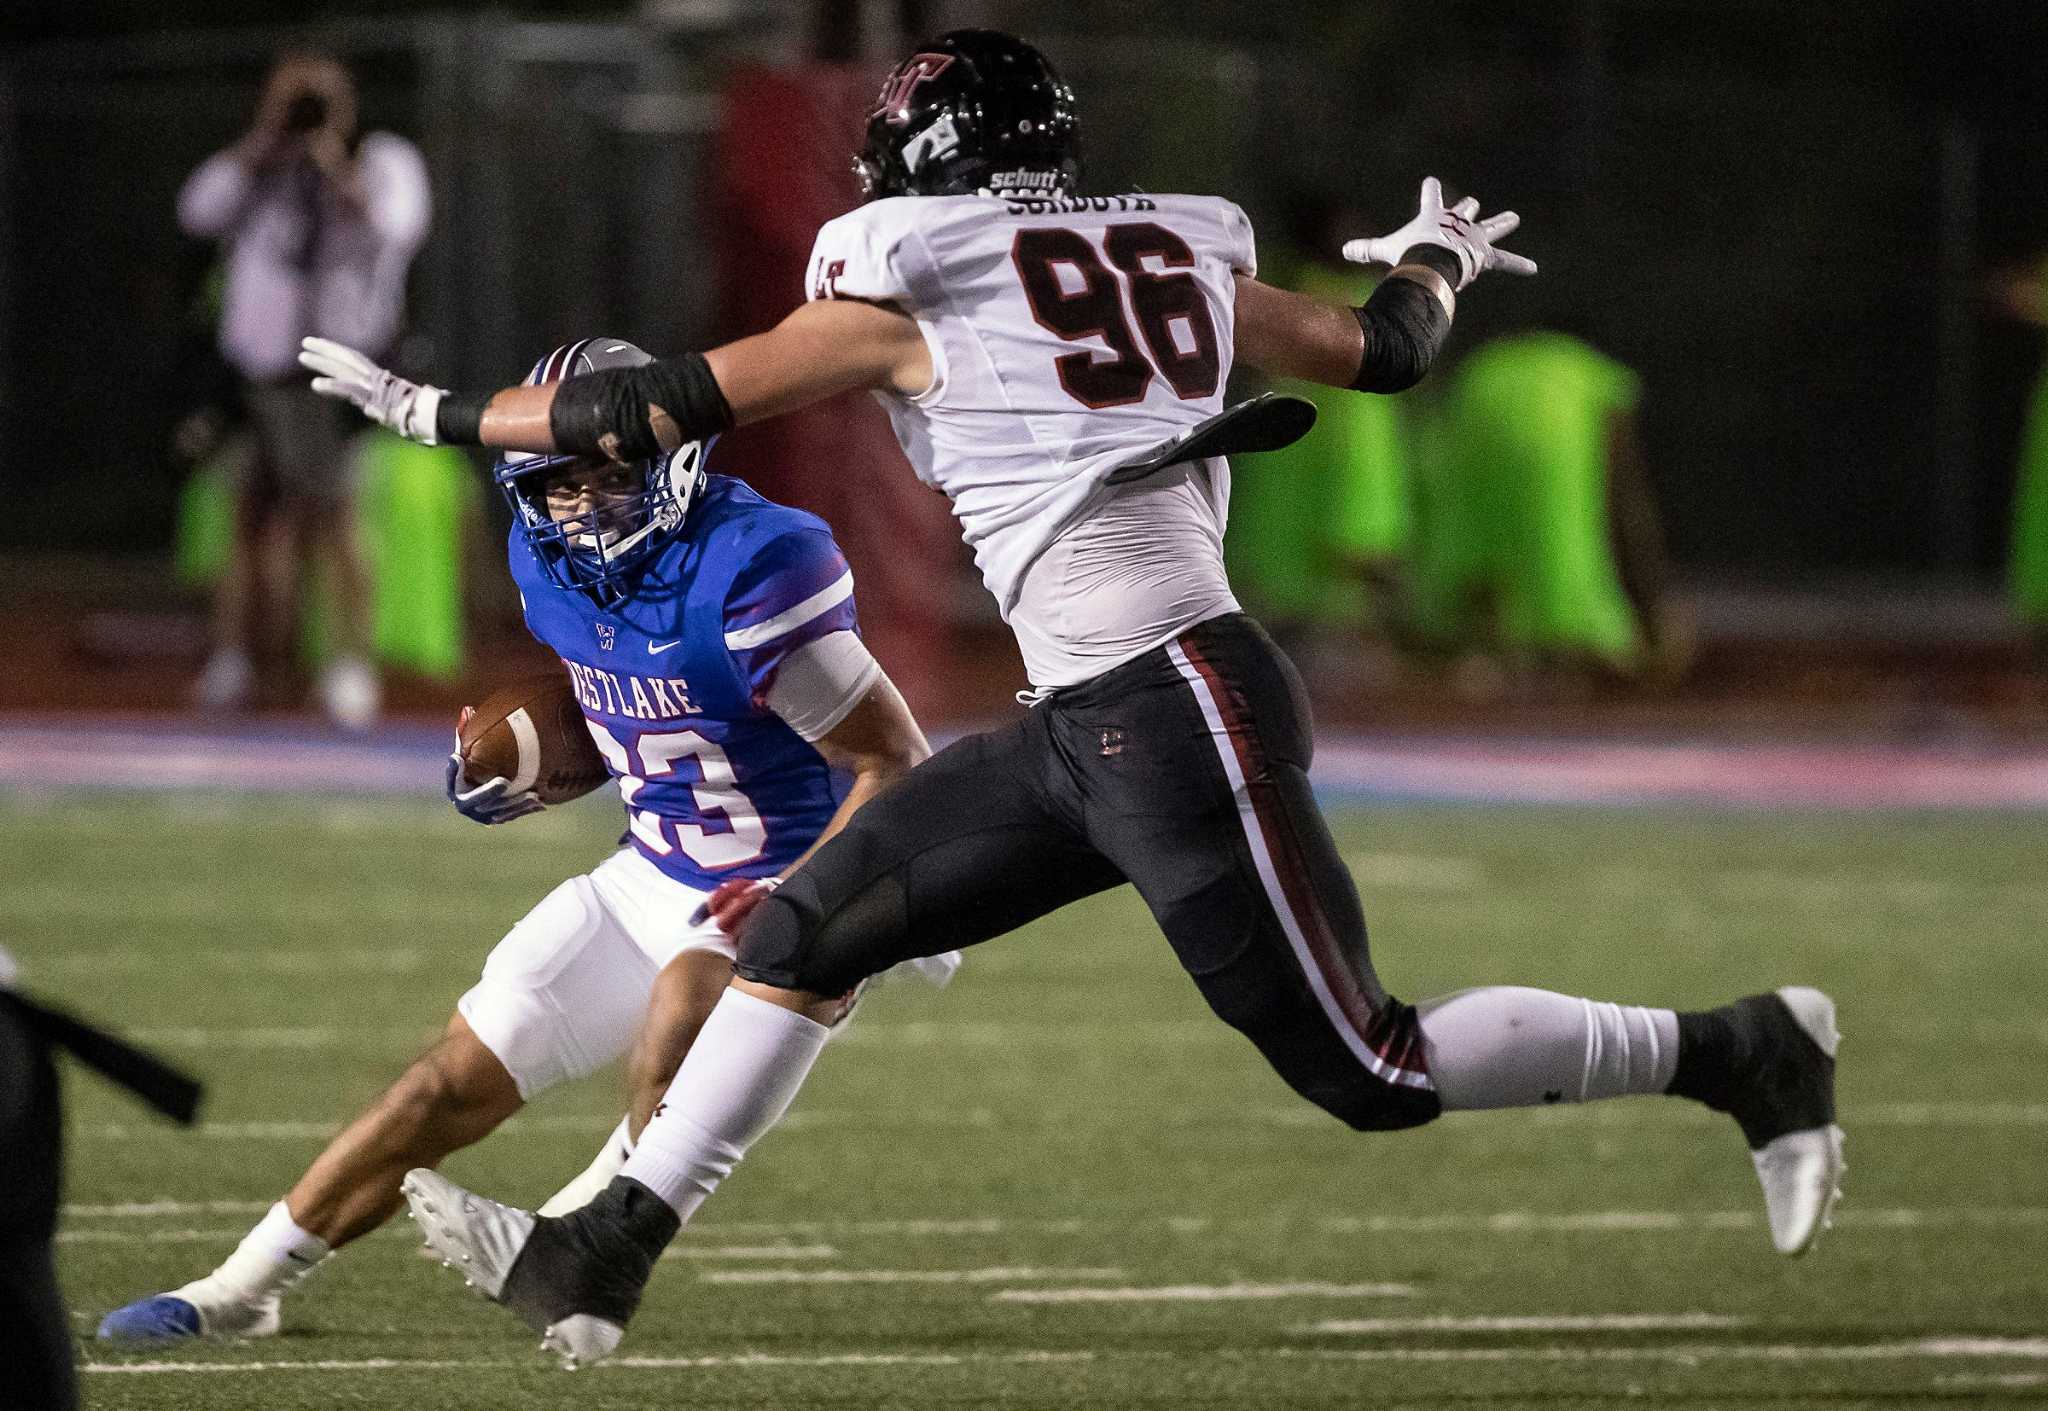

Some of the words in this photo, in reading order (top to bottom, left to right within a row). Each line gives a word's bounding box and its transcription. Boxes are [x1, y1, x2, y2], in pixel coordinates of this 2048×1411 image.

[990, 166, 1057, 188] schutt
[1010, 222, 1220, 409] 96
[587, 719, 767, 868] 23
